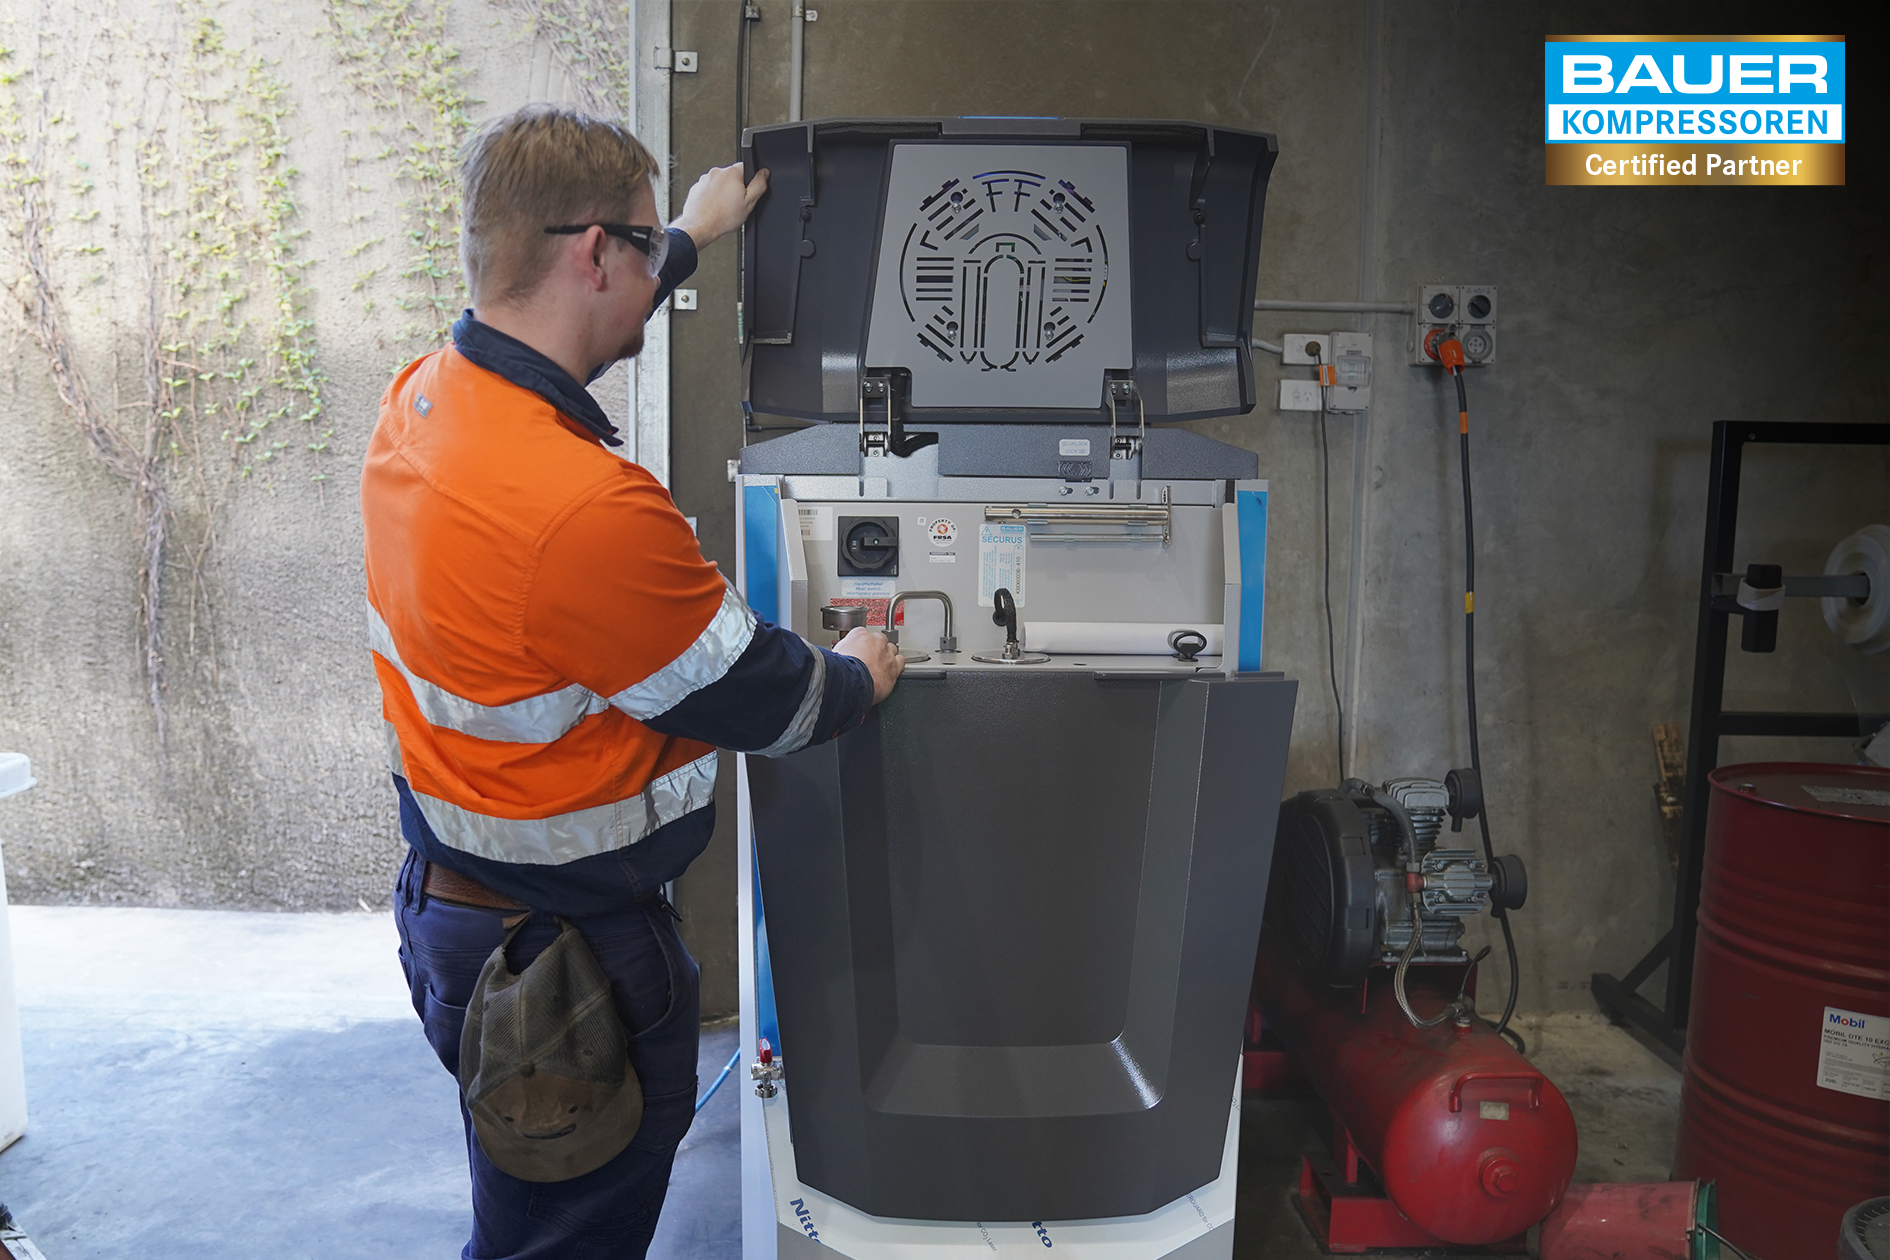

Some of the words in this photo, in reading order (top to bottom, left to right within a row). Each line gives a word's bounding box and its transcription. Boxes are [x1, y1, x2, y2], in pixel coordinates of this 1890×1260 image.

[929, 519, 951, 532] PROPERTY
[981, 535, 1023, 544] SECURUS
[1829, 1013, 1865, 1029] Mobil
[1824, 1028, 1846, 1038] MOBIL
[1848, 1033, 1862, 1041] DTE
[1824, 1034, 1848, 1043] PREMIUM
[1848, 1040, 1870, 1048] QUALITY
[790, 1197, 821, 1243] Nitt
[986, 1237, 998, 1252] Laser
